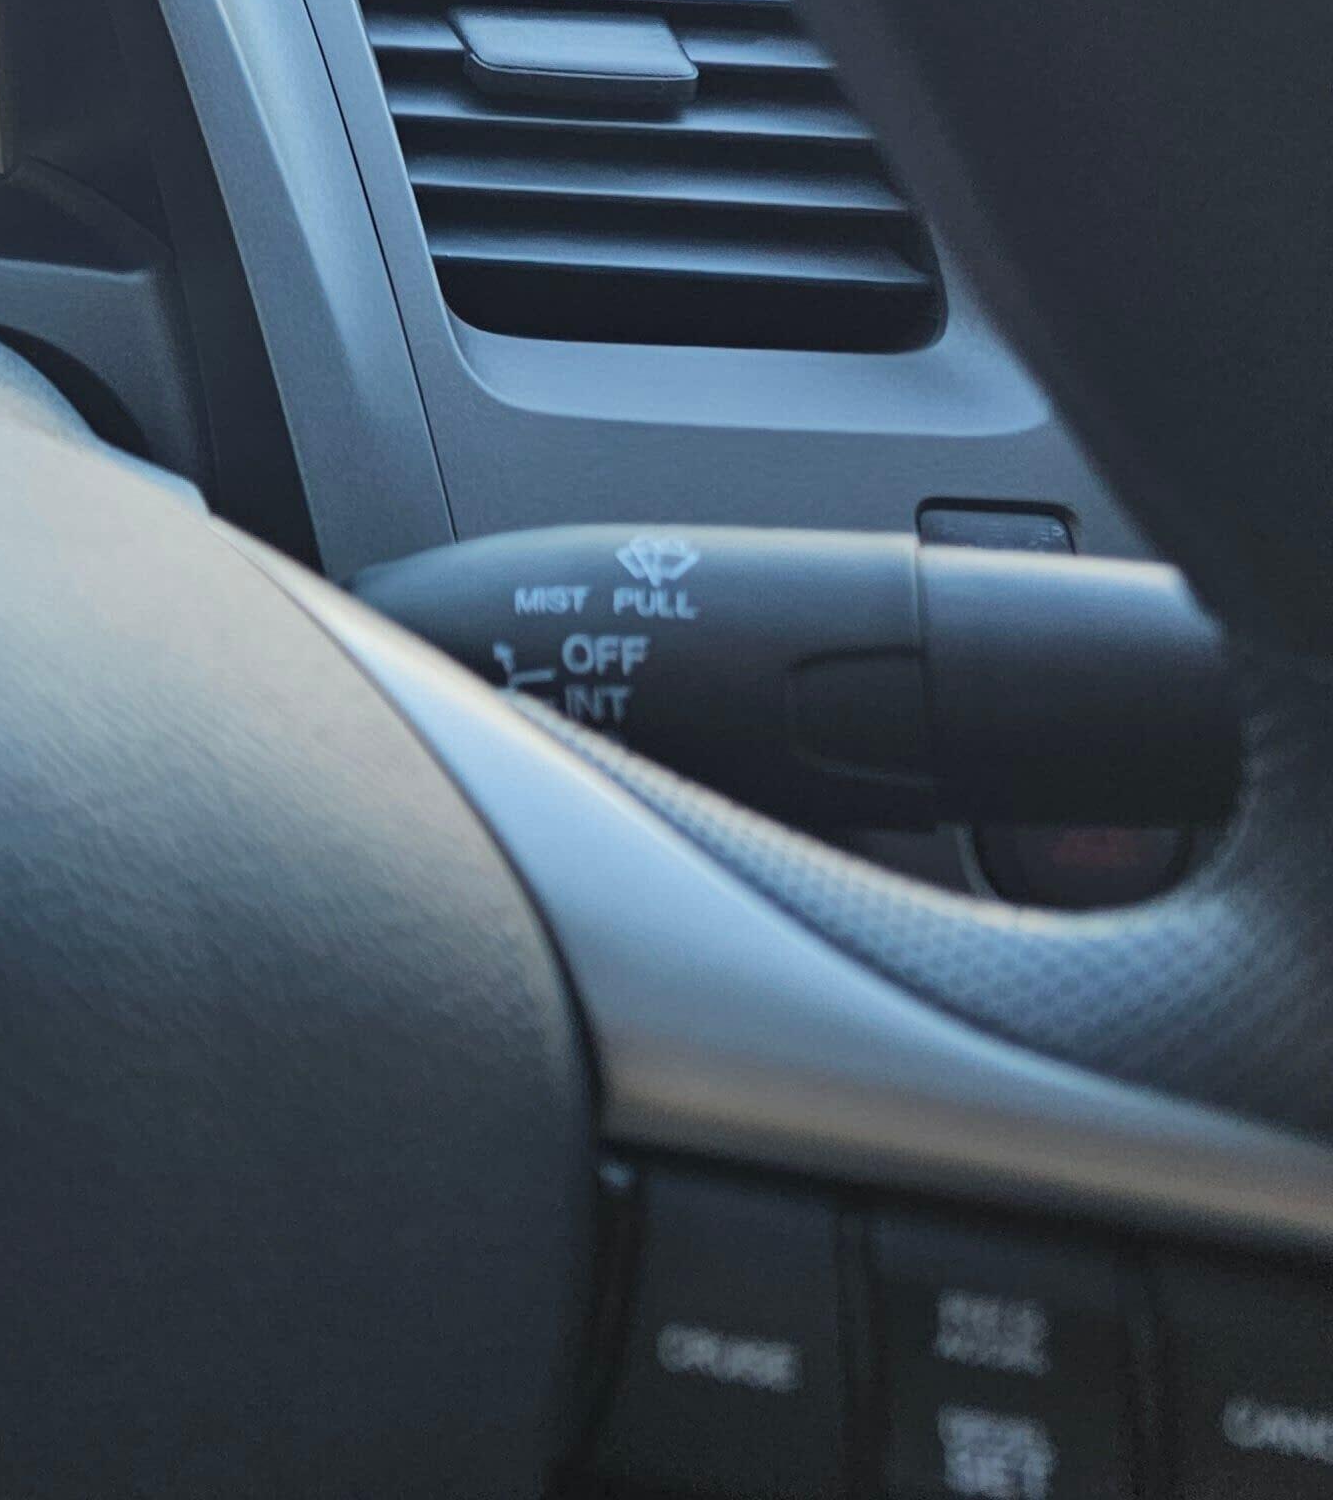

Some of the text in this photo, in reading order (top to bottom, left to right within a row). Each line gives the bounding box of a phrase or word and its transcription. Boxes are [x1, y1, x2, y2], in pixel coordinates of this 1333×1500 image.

[514, 585, 700, 620] MIST PULL
[561, 633, 651, 676] OFF
[564, 684, 630, 723] INT
